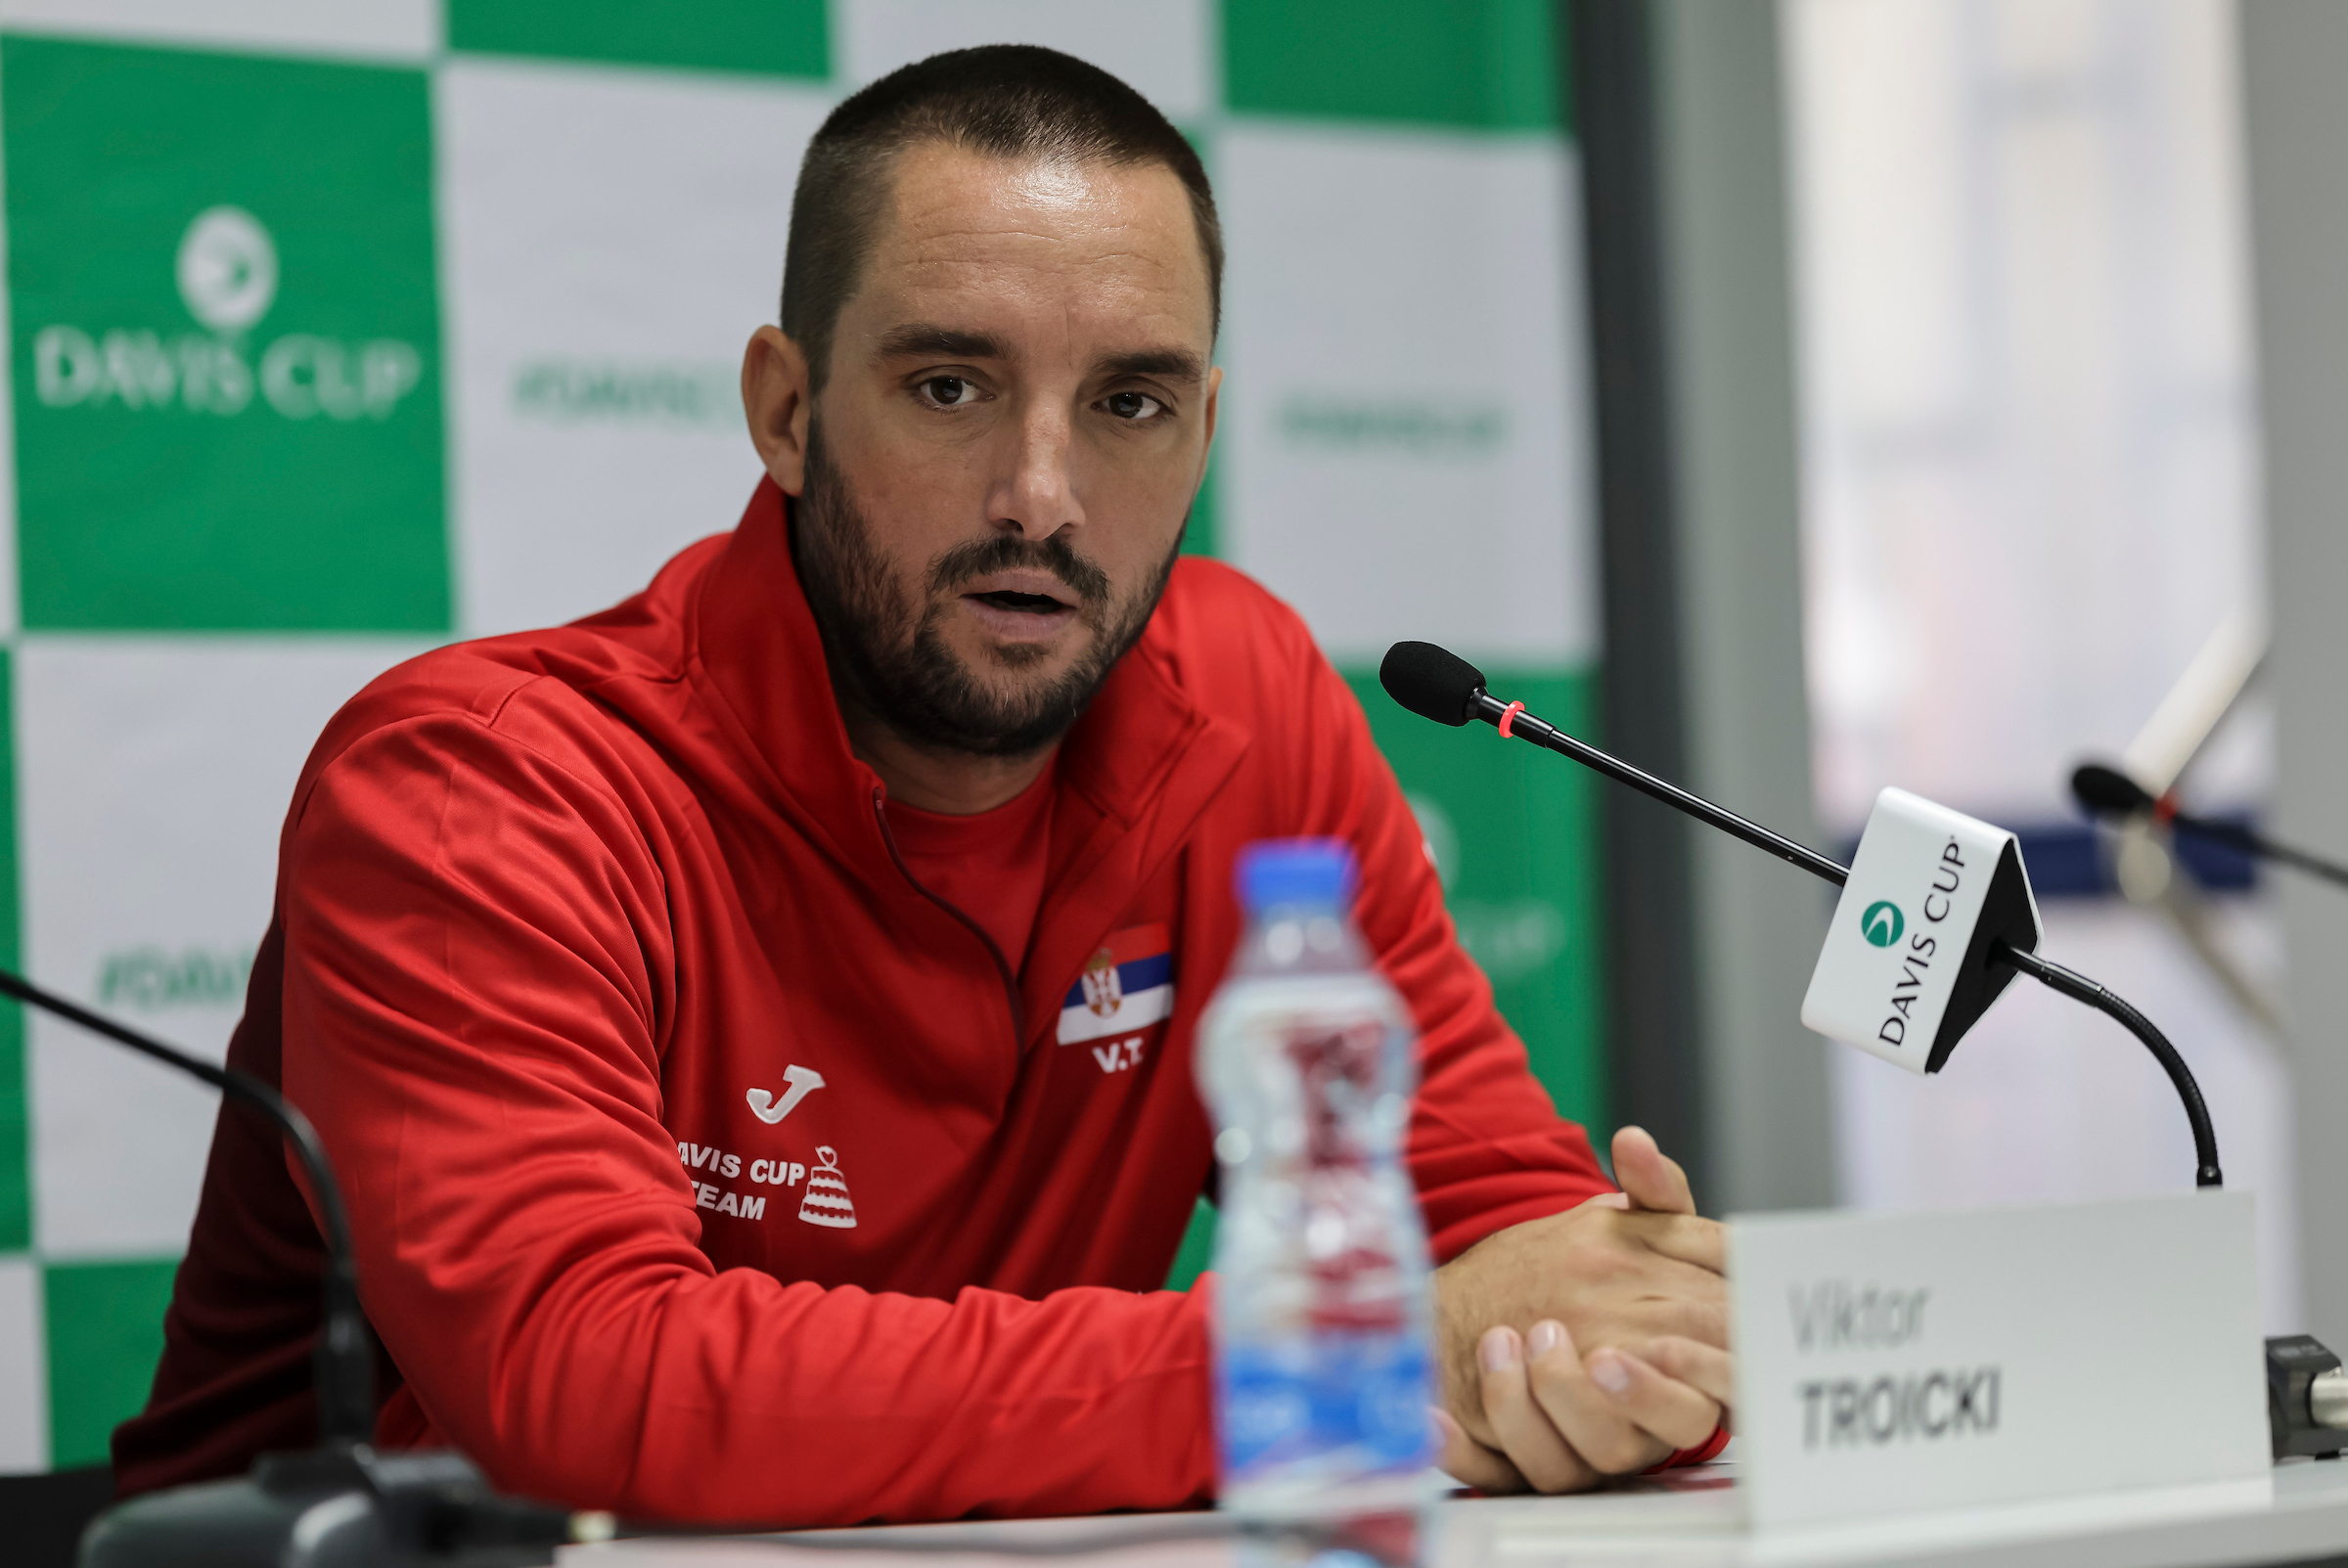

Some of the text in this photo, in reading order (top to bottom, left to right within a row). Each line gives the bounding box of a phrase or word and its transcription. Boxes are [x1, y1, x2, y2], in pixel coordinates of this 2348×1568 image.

[35, 325, 422, 422] DAVIS CUP
[1878, 842, 1965, 1046] DAVIS CUP
[749, 1158, 805, 1187] CUP
[1798, 1365, 2002, 1452] TROICKI
